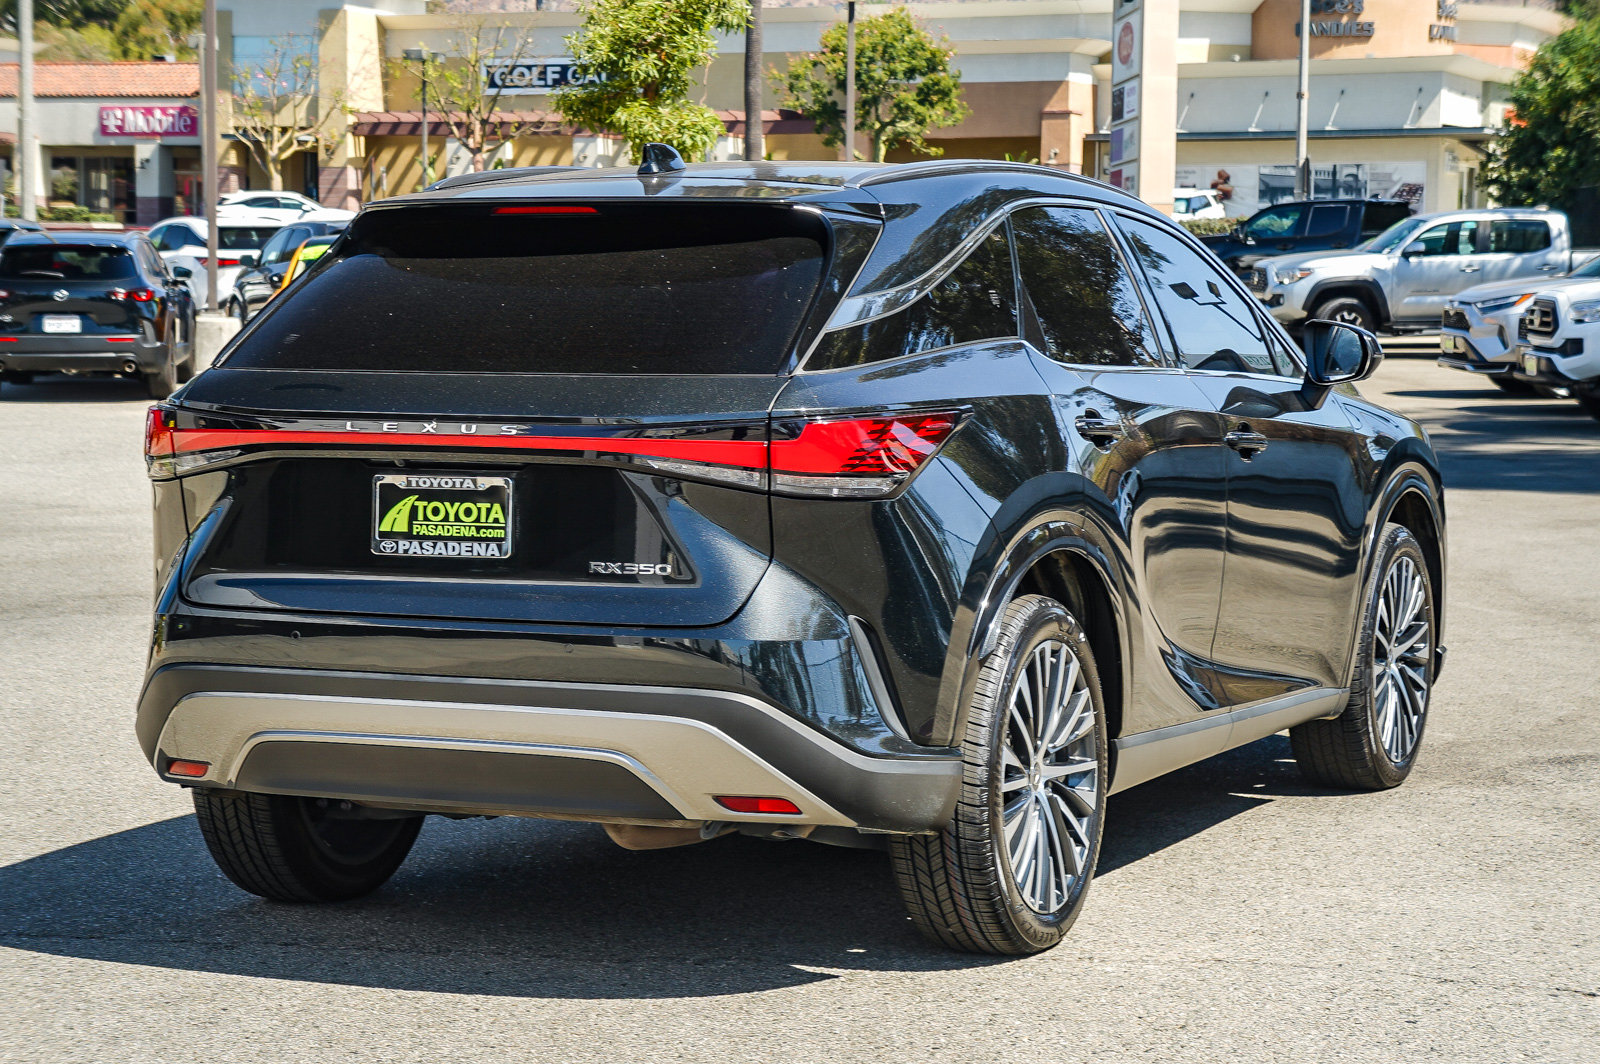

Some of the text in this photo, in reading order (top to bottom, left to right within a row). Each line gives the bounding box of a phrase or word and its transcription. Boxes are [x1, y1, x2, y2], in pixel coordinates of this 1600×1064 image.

[494, 66, 562, 87] GOLF
[345, 420, 518, 436] LEXUS
[408, 477, 476, 489] TOYOTA
[413, 501, 506, 523] TOYOTA
[412, 524, 505, 538] PASADENA.com
[397, 540, 501, 557] PASADENA
